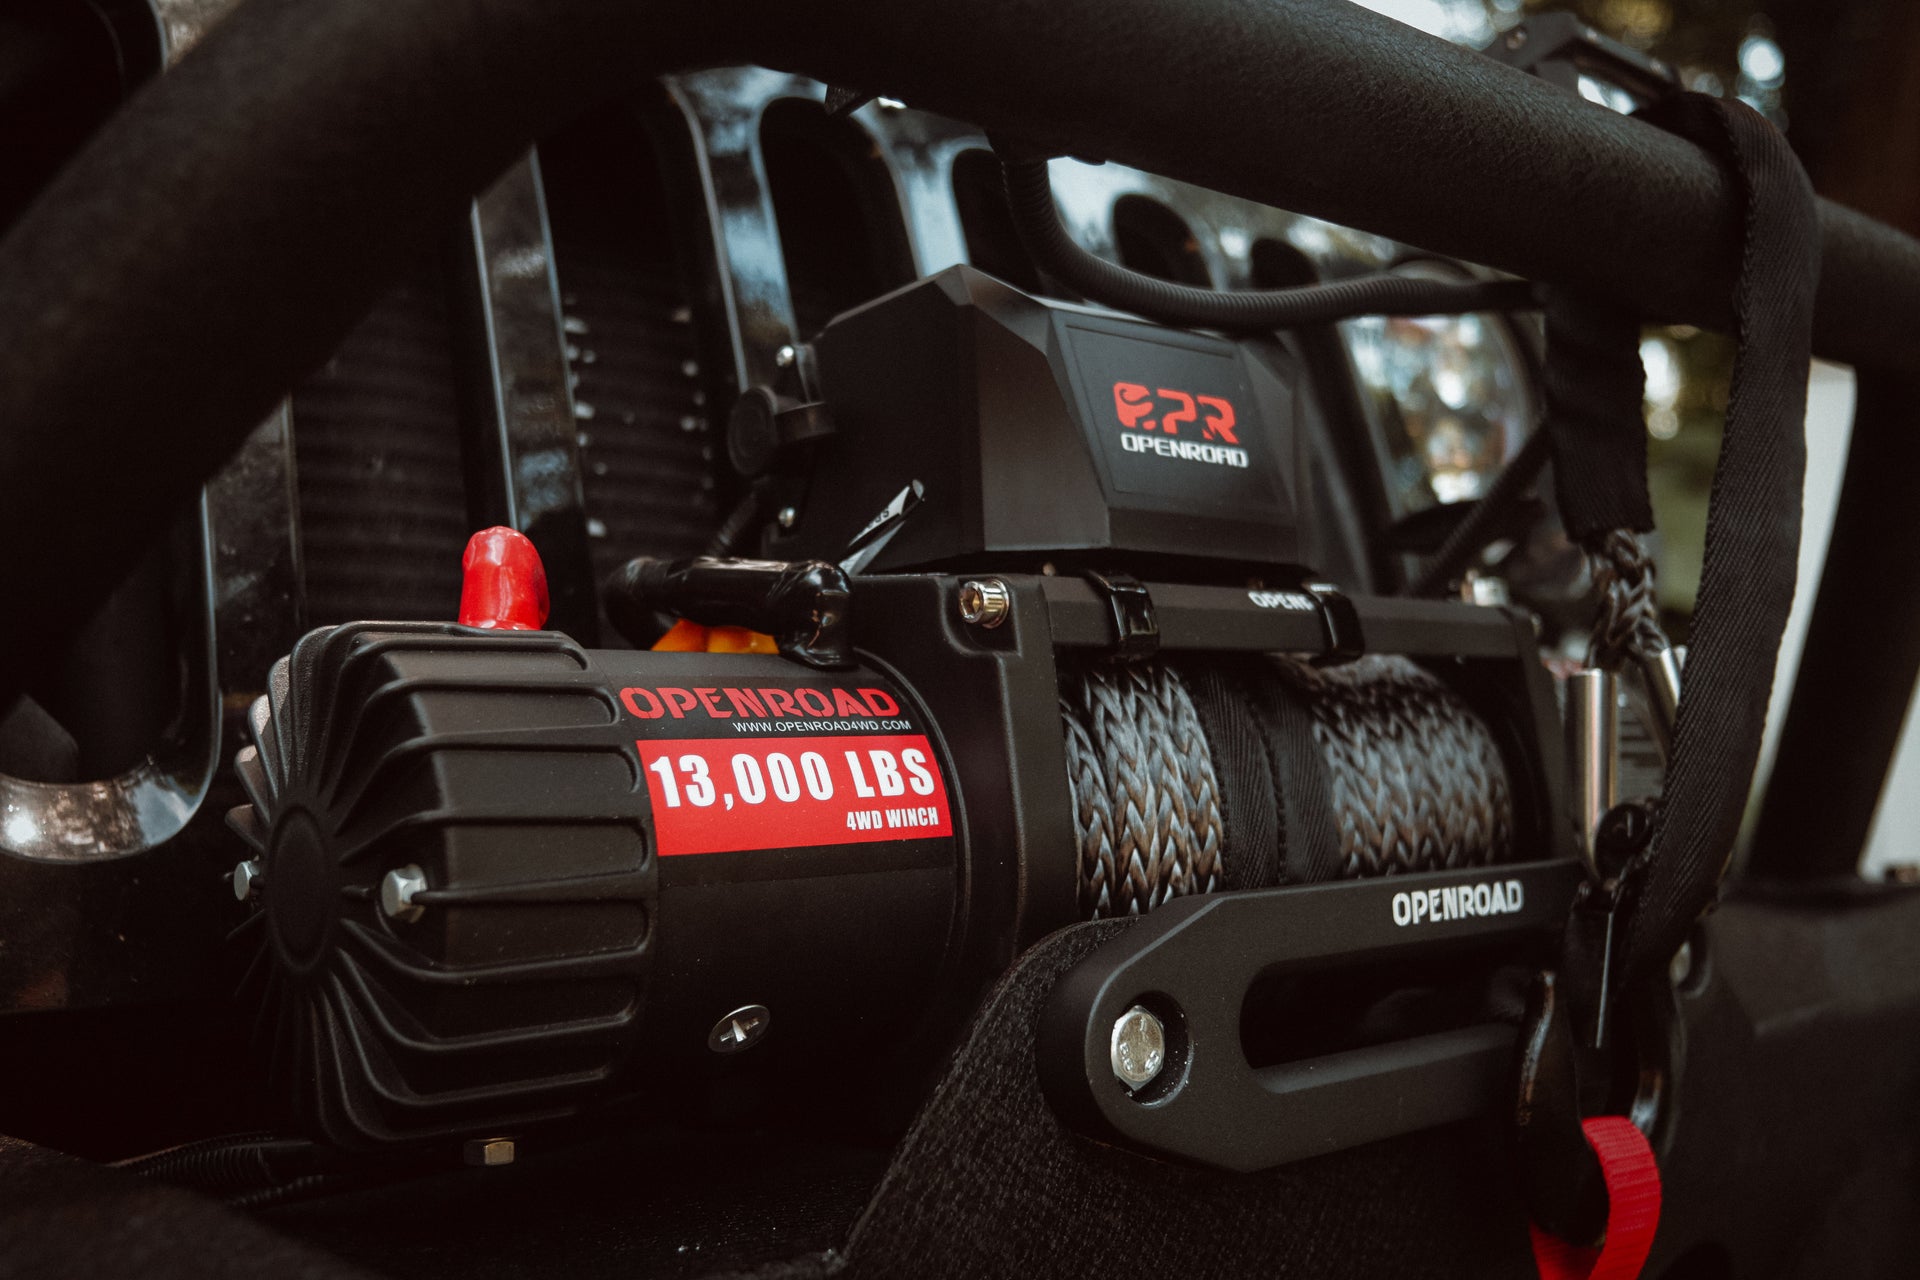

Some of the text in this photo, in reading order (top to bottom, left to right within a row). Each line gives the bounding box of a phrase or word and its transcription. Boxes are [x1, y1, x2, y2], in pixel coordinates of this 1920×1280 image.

[1120, 432, 1249, 468] OPENROAD
[619, 687, 900, 719] OPENROAD
[732, 720, 912, 733] WWW.OPENROAD4WD.COM
[649, 748, 935, 811] 13,000 LBS
[846, 807, 939, 831] 4WD WINCH
[1392, 880, 1524, 926] OPENROAD
